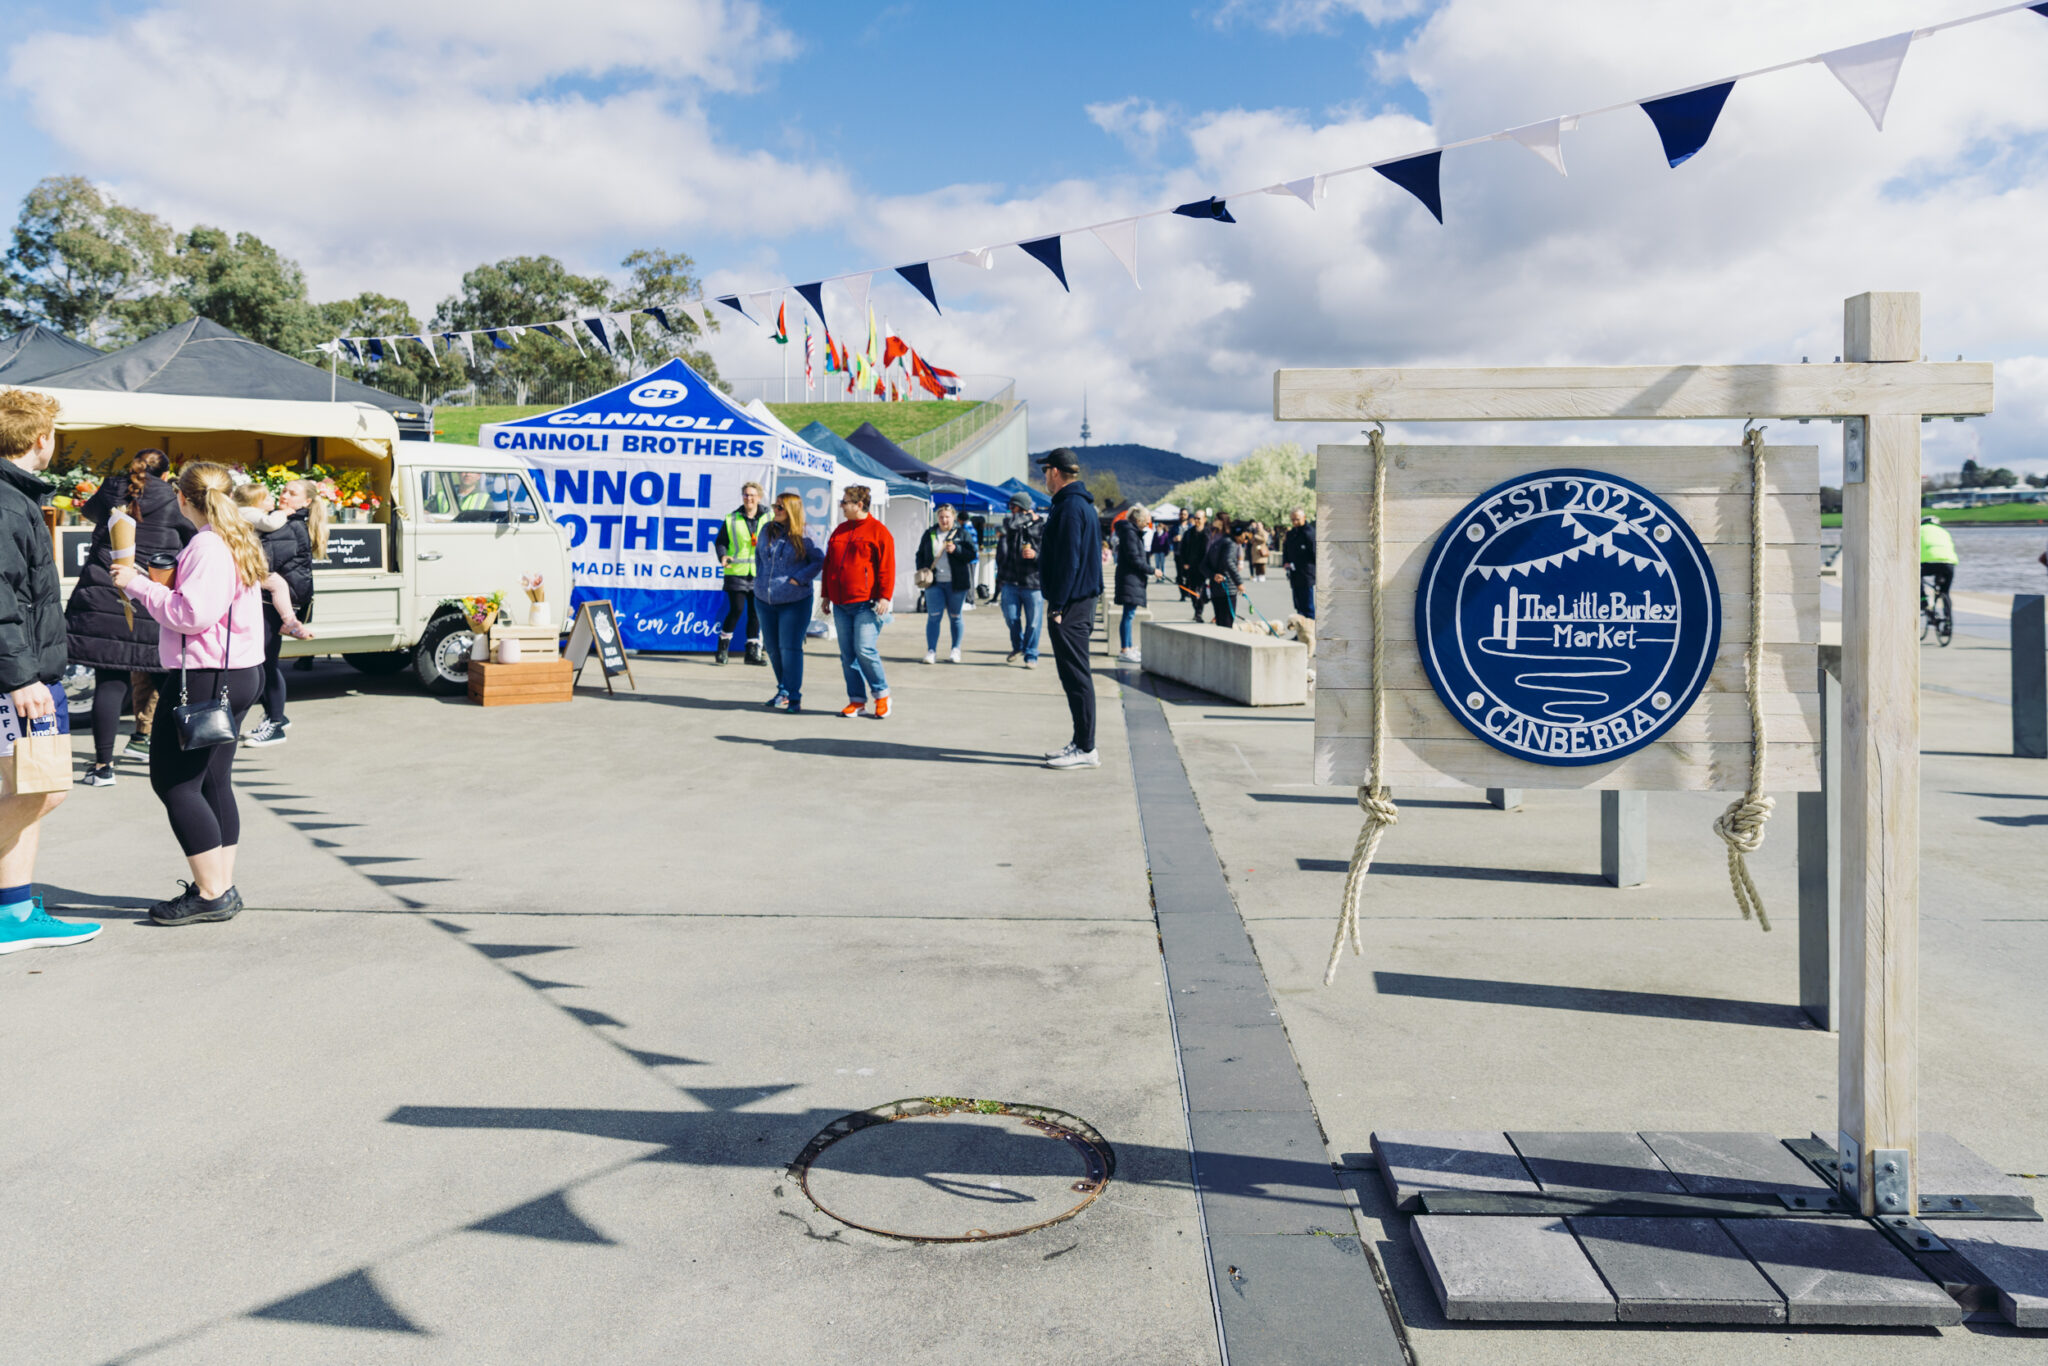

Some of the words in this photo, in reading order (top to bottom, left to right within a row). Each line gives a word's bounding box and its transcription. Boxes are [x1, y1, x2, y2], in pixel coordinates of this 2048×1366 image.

[638, 388, 679, 399] CB
[547, 412, 735, 431] CANNOLI
[494, 431, 609, 451] CANNOLI
[622, 435, 764, 458] BROTHERS
[1483, 482, 1554, 532] EST
[1562, 479, 1658, 534] 2022
[555, 513, 724, 552] OTHER
[634, 563, 653, 577] IN
[660, 564, 724, 579] CANBE
[1485, 708, 1656, 754] CANBERRA
